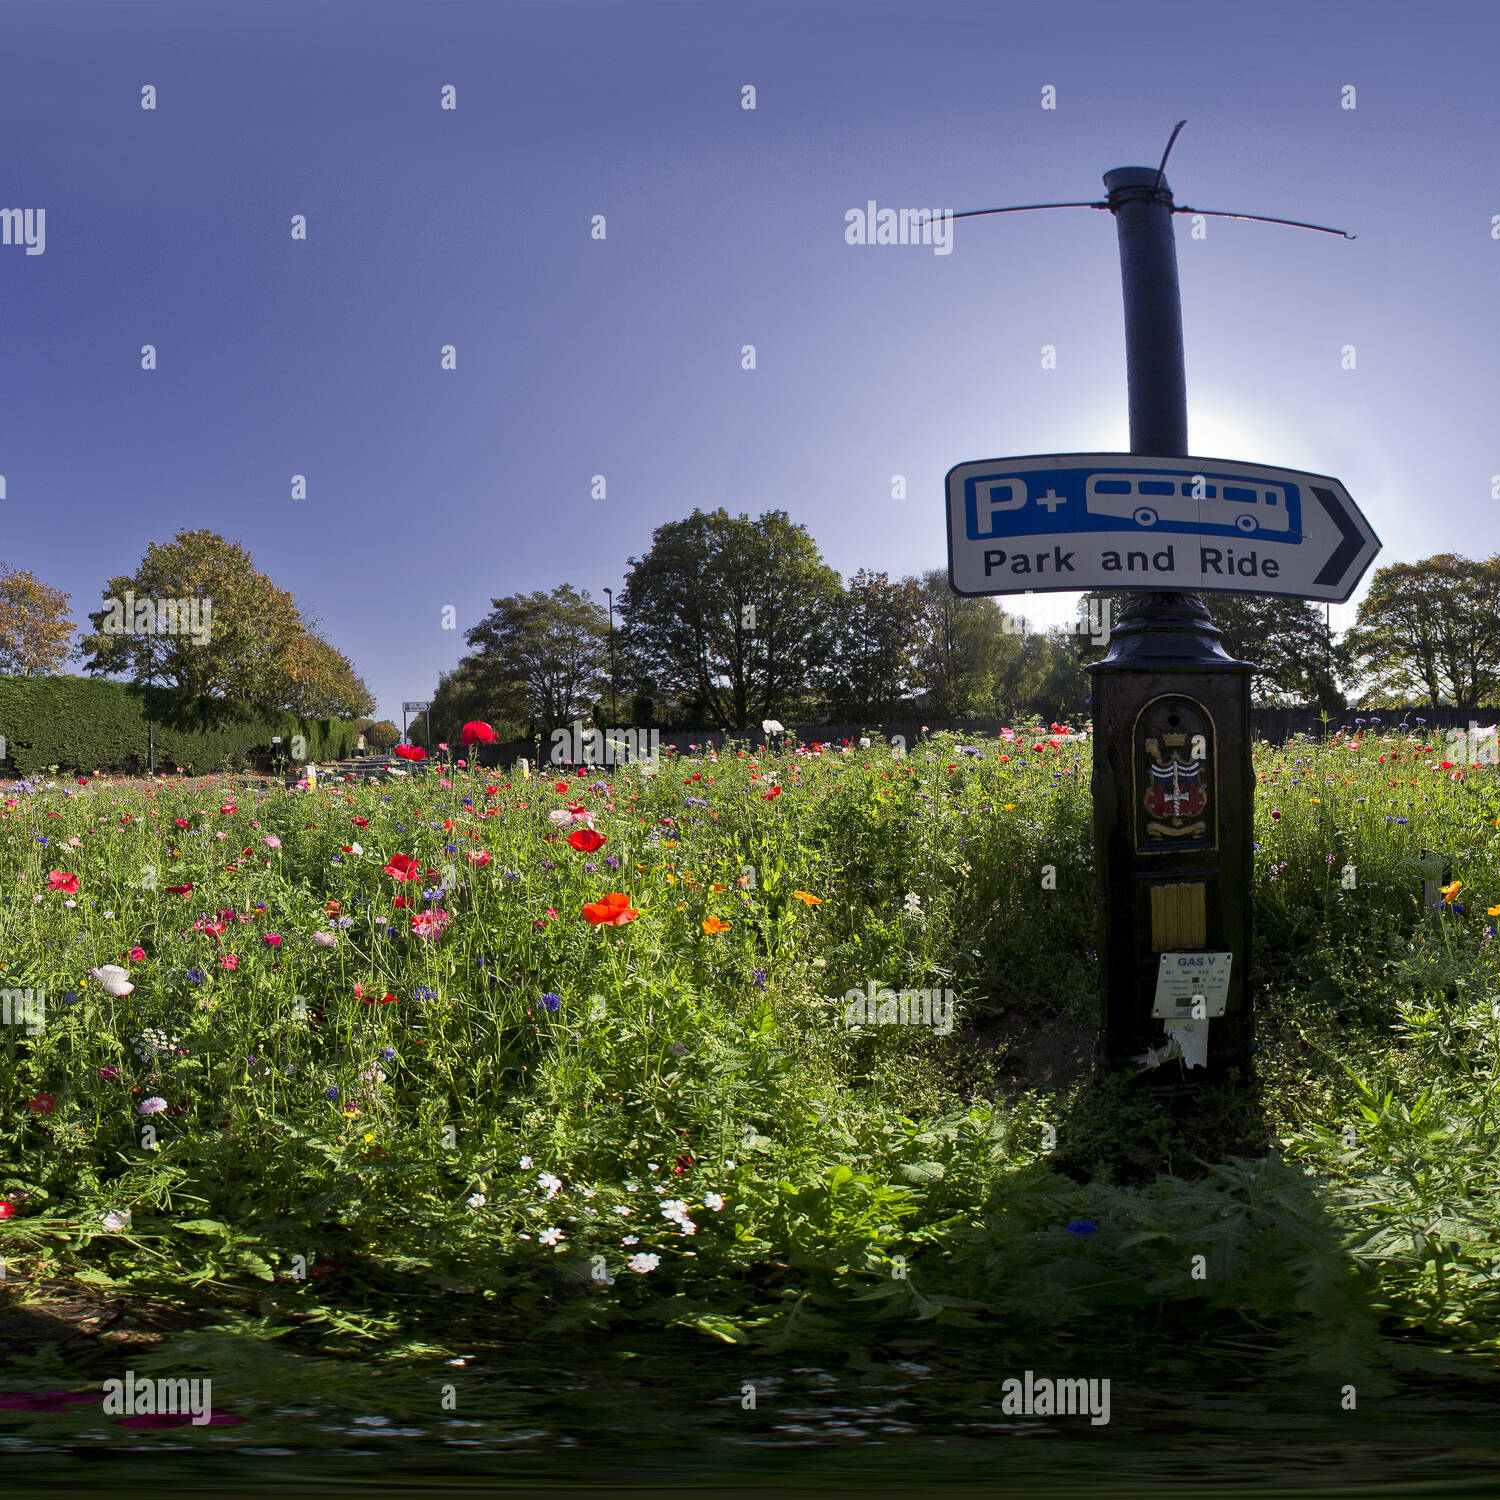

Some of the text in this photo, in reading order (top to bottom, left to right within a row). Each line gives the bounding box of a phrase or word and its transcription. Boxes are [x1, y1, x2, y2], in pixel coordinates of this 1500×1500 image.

[984, 545, 1280, 578] Park and Ride
[1178, 957, 1216, 966] GAS V
